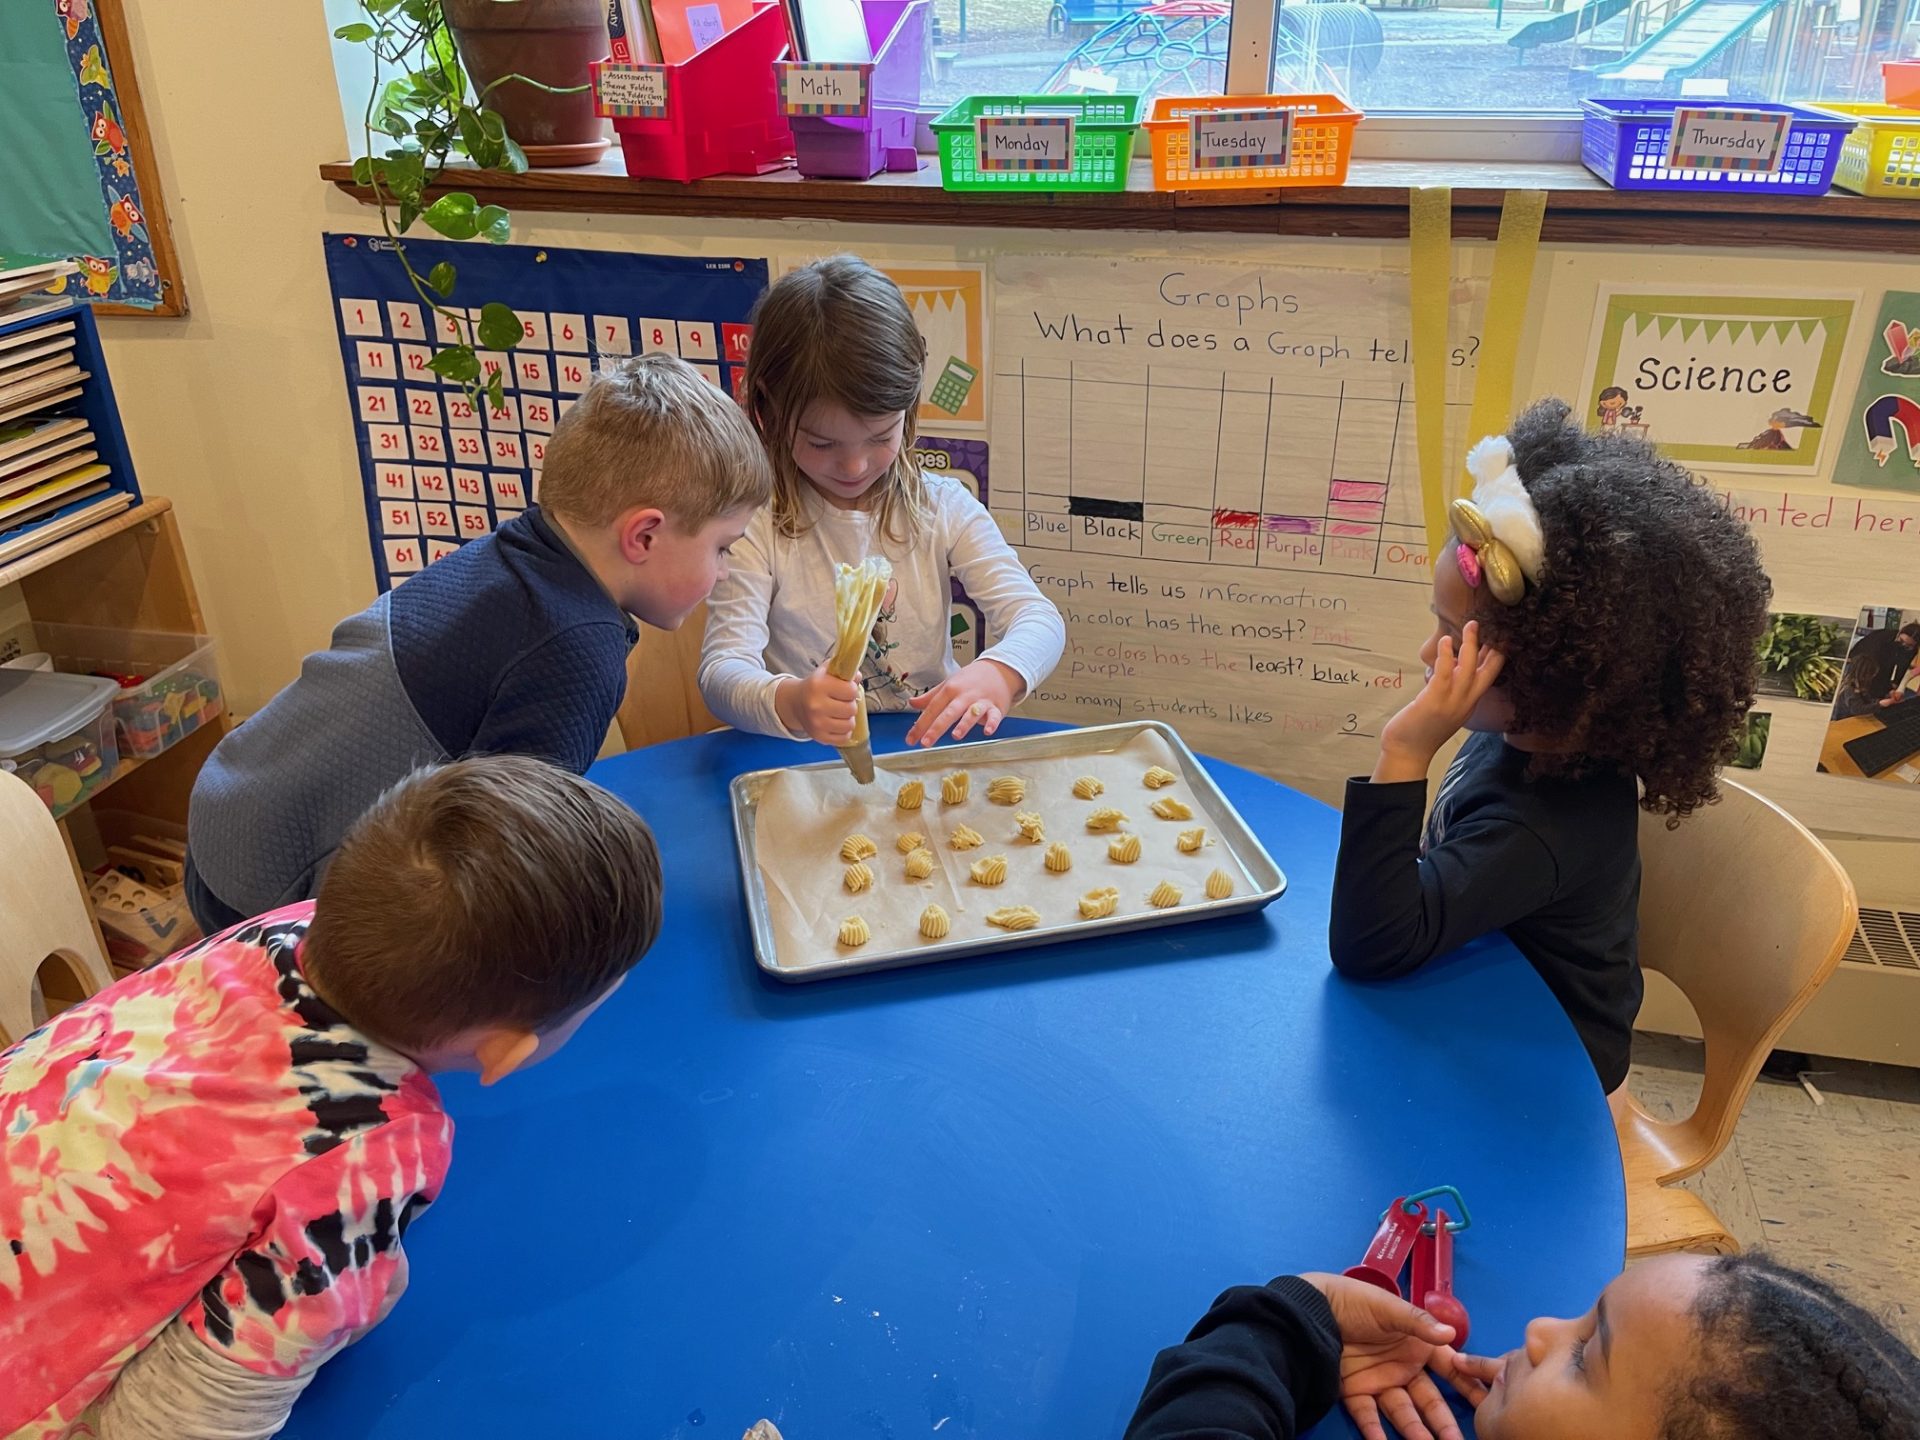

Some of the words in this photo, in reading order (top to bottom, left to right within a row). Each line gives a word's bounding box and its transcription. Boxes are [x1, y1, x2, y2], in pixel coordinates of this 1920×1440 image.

[801, 76, 841, 96] Math
[995, 134, 1050, 156] Monday
[1202, 131, 1267, 154] Tuesday
[1692, 128, 1765, 152] Thursday
[1160, 272, 1298, 325] Graphs
[356, 308, 364, 325] 1
[400, 312, 411, 328] 2
[446, 315, 456, 332] 3
[524, 321, 535, 337] 5
[563, 324, 574, 340] 6
[606, 326, 616, 342] 7
[653, 328, 664, 345] 8
[690, 331, 702, 348] 9
[732, 333, 750, 351] 10
[1034, 311, 1133, 344] What
[1147, 319, 1217, 350] does
[1233, 337, 1250, 351] a
[1268, 332, 1350, 368] Graph
[368, 352, 383, 368] 11
[408, 354, 425, 370] 12
[523, 363, 540, 380] 15
[564, 366, 582, 383] 16
[1635, 357, 1792, 393] Science
[368, 396, 386, 412] 21
[413, 399, 433, 415] 22
[451, 402, 472, 418] 23
[492, 405, 511, 420] 24
[528, 405, 549, 422] 25
[380, 433, 398, 449] 31
[418, 435, 439, 451] 32
[458, 438, 479, 454] 33
[496, 442, 516, 458] 34
[534, 444, 544, 460] 3
[386, 473, 404, 488] 41
[422, 476, 443, 491] 42
[459, 478, 479, 494] 43
[497, 482, 518, 498] 44
[392, 510, 410, 525] 51
[426, 512, 448, 526] 52
[464, 515, 485, 530] 53
[1027, 512, 1069, 533] Blue
[1084, 516, 1141, 541] Black
[1151, 523, 1209, 546] Green
[1220, 528, 1255, 550] Red
[1266, 533, 1320, 561] Purple
[1330, 537, 1374, 560] Pink
[395, 548, 413, 562] 61
[1028, 564, 1094, 596] Graph
[1107, 572, 1148, 594] tells
[1161, 585, 1186, 599] us
[1087, 609, 1133, 627] color
[1146, 609, 1180, 630] has
[1187, 613, 1224, 636] the
[1232, 619, 1306, 641] most?
[1312, 627, 1353, 643] Pink
[1071, 661, 1136, 678] purple
[1094, 642, 1147, 661] colors
[1153, 645, 1191, 666] has
[1201, 649, 1238, 672] the
[1249, 655, 1304, 677] least?
[1374, 668, 1402, 689] red
[1076, 695, 1122, 716] many
[1134, 699, 1217, 719] students
[1229, 704, 1273, 724] likes
[1342, 713, 1358, 732] 3
